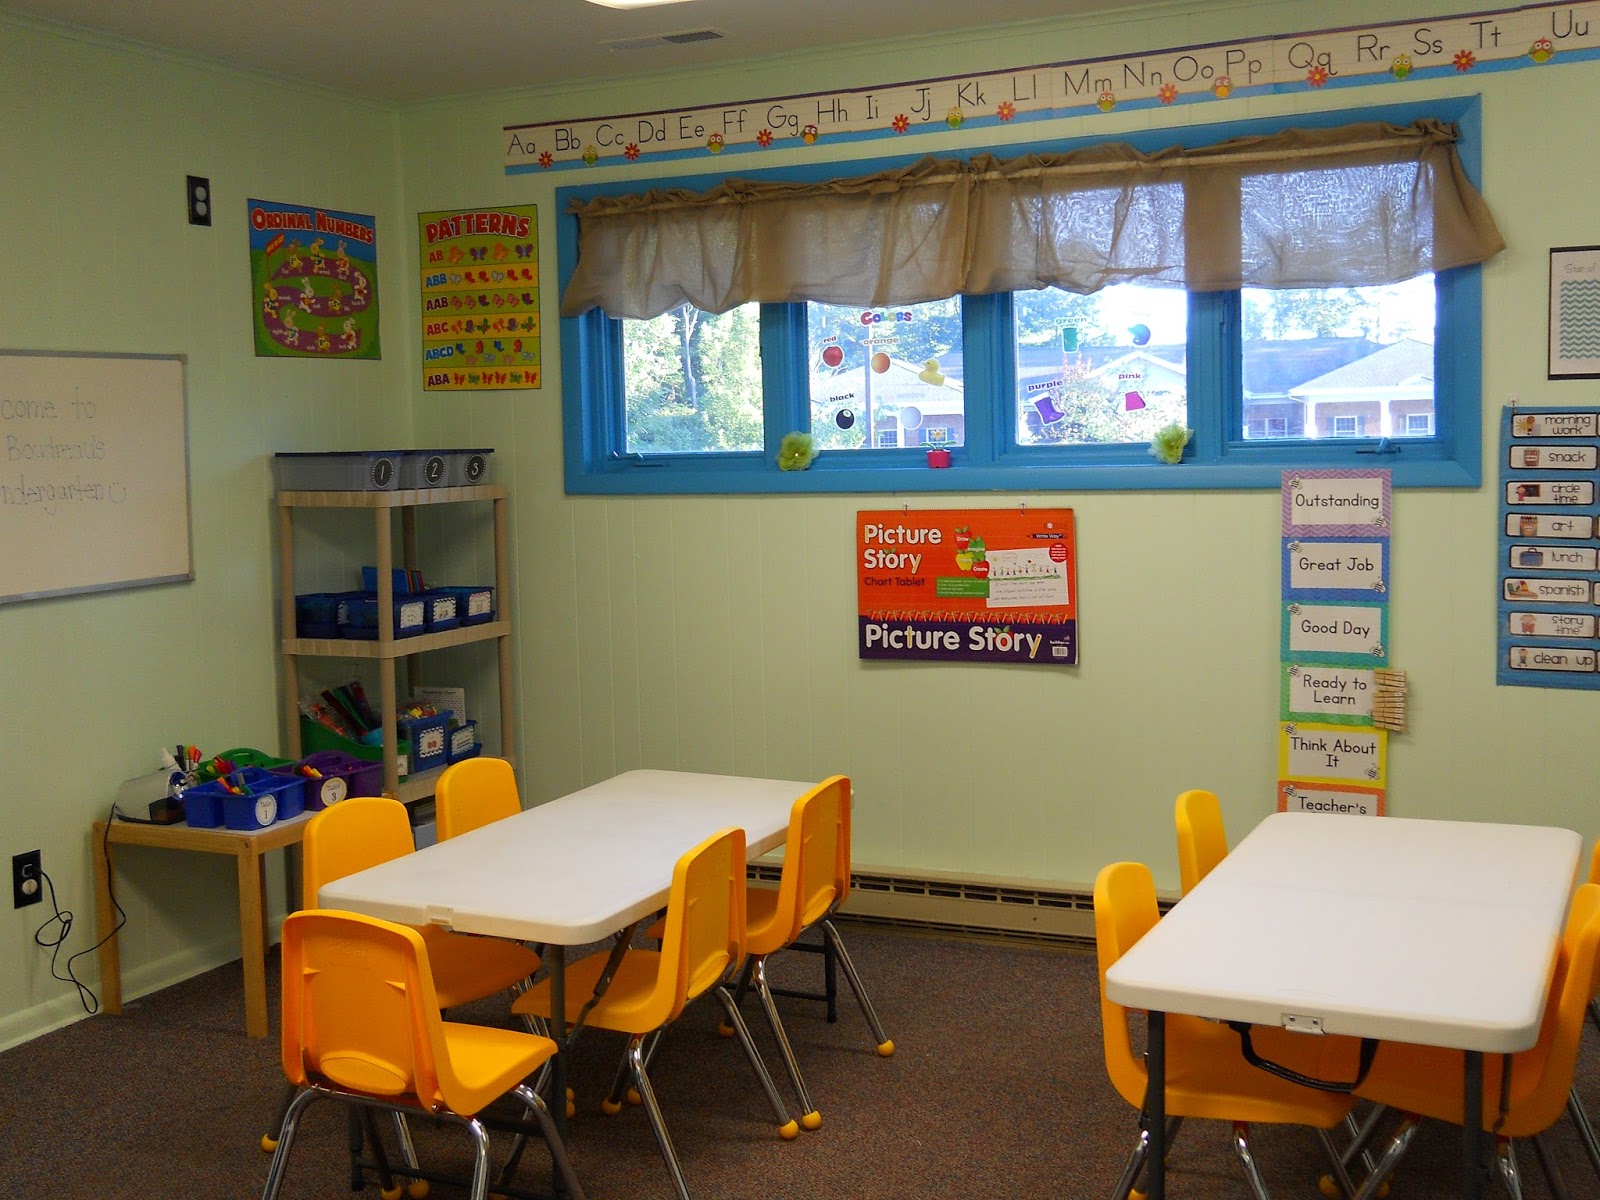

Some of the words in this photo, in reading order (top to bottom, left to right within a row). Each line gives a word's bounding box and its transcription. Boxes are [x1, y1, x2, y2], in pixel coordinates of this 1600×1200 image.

[507, 134, 536, 156] Aa
[555, 128, 581, 151] Bb
[595, 124, 624, 146] Cc
[638, 119, 666, 143] Dd
[679, 115, 705, 139] Ee
[723, 110, 747, 135] Ff
[767, 105, 799, 137] Gg
[816, 100, 848, 124] Hh
[865, 95, 878, 120] Ii
[911, 87, 931, 122] Jj
[957, 81, 986, 107] Kk
[1013, 74, 1036, 101] Ll
[1064, 68, 1112, 96] Mm
[1124, 61, 1162, 89] Nn
[1173, 56, 1214, 82] Oo
[1226, 50, 1262, 84] Pp
[1288, 42, 1338, 76] Qq
[1357, 34, 1390, 63] Rr
[1413, 28, 1443, 55] Ss
[1470, 20, 1501, 49] Tt
[1552, 9, 1588, 38] Uu
[251, 207, 313, 231] ORDINAL
[315, 210, 374, 244] NUMBERS
[425, 211, 531, 245] PATTERNS
[428, 249, 444, 263] AB
[425, 272, 448, 288] ABB
[426, 296, 449, 311] AAB
[426, 321, 449, 336] ABC
[1055, 317, 1087, 326] green
[823, 336, 837, 344] red
[863, 337, 899, 346] orange
[425, 345, 454, 360] ABCD
[427, 373, 450, 387] ABA
[1028, 380, 1063, 392] purple
[71, 386, 96, 420] to
[829, 392, 855, 403] black
[1545, 414, 1591, 427] morning
[1552, 425, 1583, 435] work
[1549, 451, 1587, 462] snack
[380, 465, 385, 479] 1
[431, 462, 438, 478] 2
[471, 462, 479, 476] 3
[1551, 483, 1580, 493] circle
[1295, 493, 1379, 509] Outstanding
[1553, 493, 1578, 504] time
[1552, 520, 1574, 531] art
[863, 523, 942, 545] Picture
[863, 549, 922, 574] Story
[1299, 557, 1341, 571] Great
[1347, 557, 1374, 571] Job
[1552, 551, 1583, 563] lunch
[864, 576, 893, 587] Chart
[896, 577, 925, 587] Tablet
[1539, 584, 1585, 596] spanish
[1301, 619, 1337, 634] Good
[1343, 621, 1370, 638] Day
[1552, 616, 1584, 628] story
[1555, 626, 1580, 635] time
[865, 623, 961, 650] Picture
[968, 626, 1043, 659] Story
[1533, 652, 1568, 665] clean
[1576, 655, 1594, 667] up
[1303, 674, 1347, 692] Ready
[1352, 677, 1367, 690] to
[1313, 690, 1356, 705] Learn
[1290, 736, 1327, 751] Think
[1333, 739, 1376, 755] About
[1325, 754, 1339, 768] It
[332, 792, 337, 801] 3
[1298, 796, 1367, 815] Teacher's
